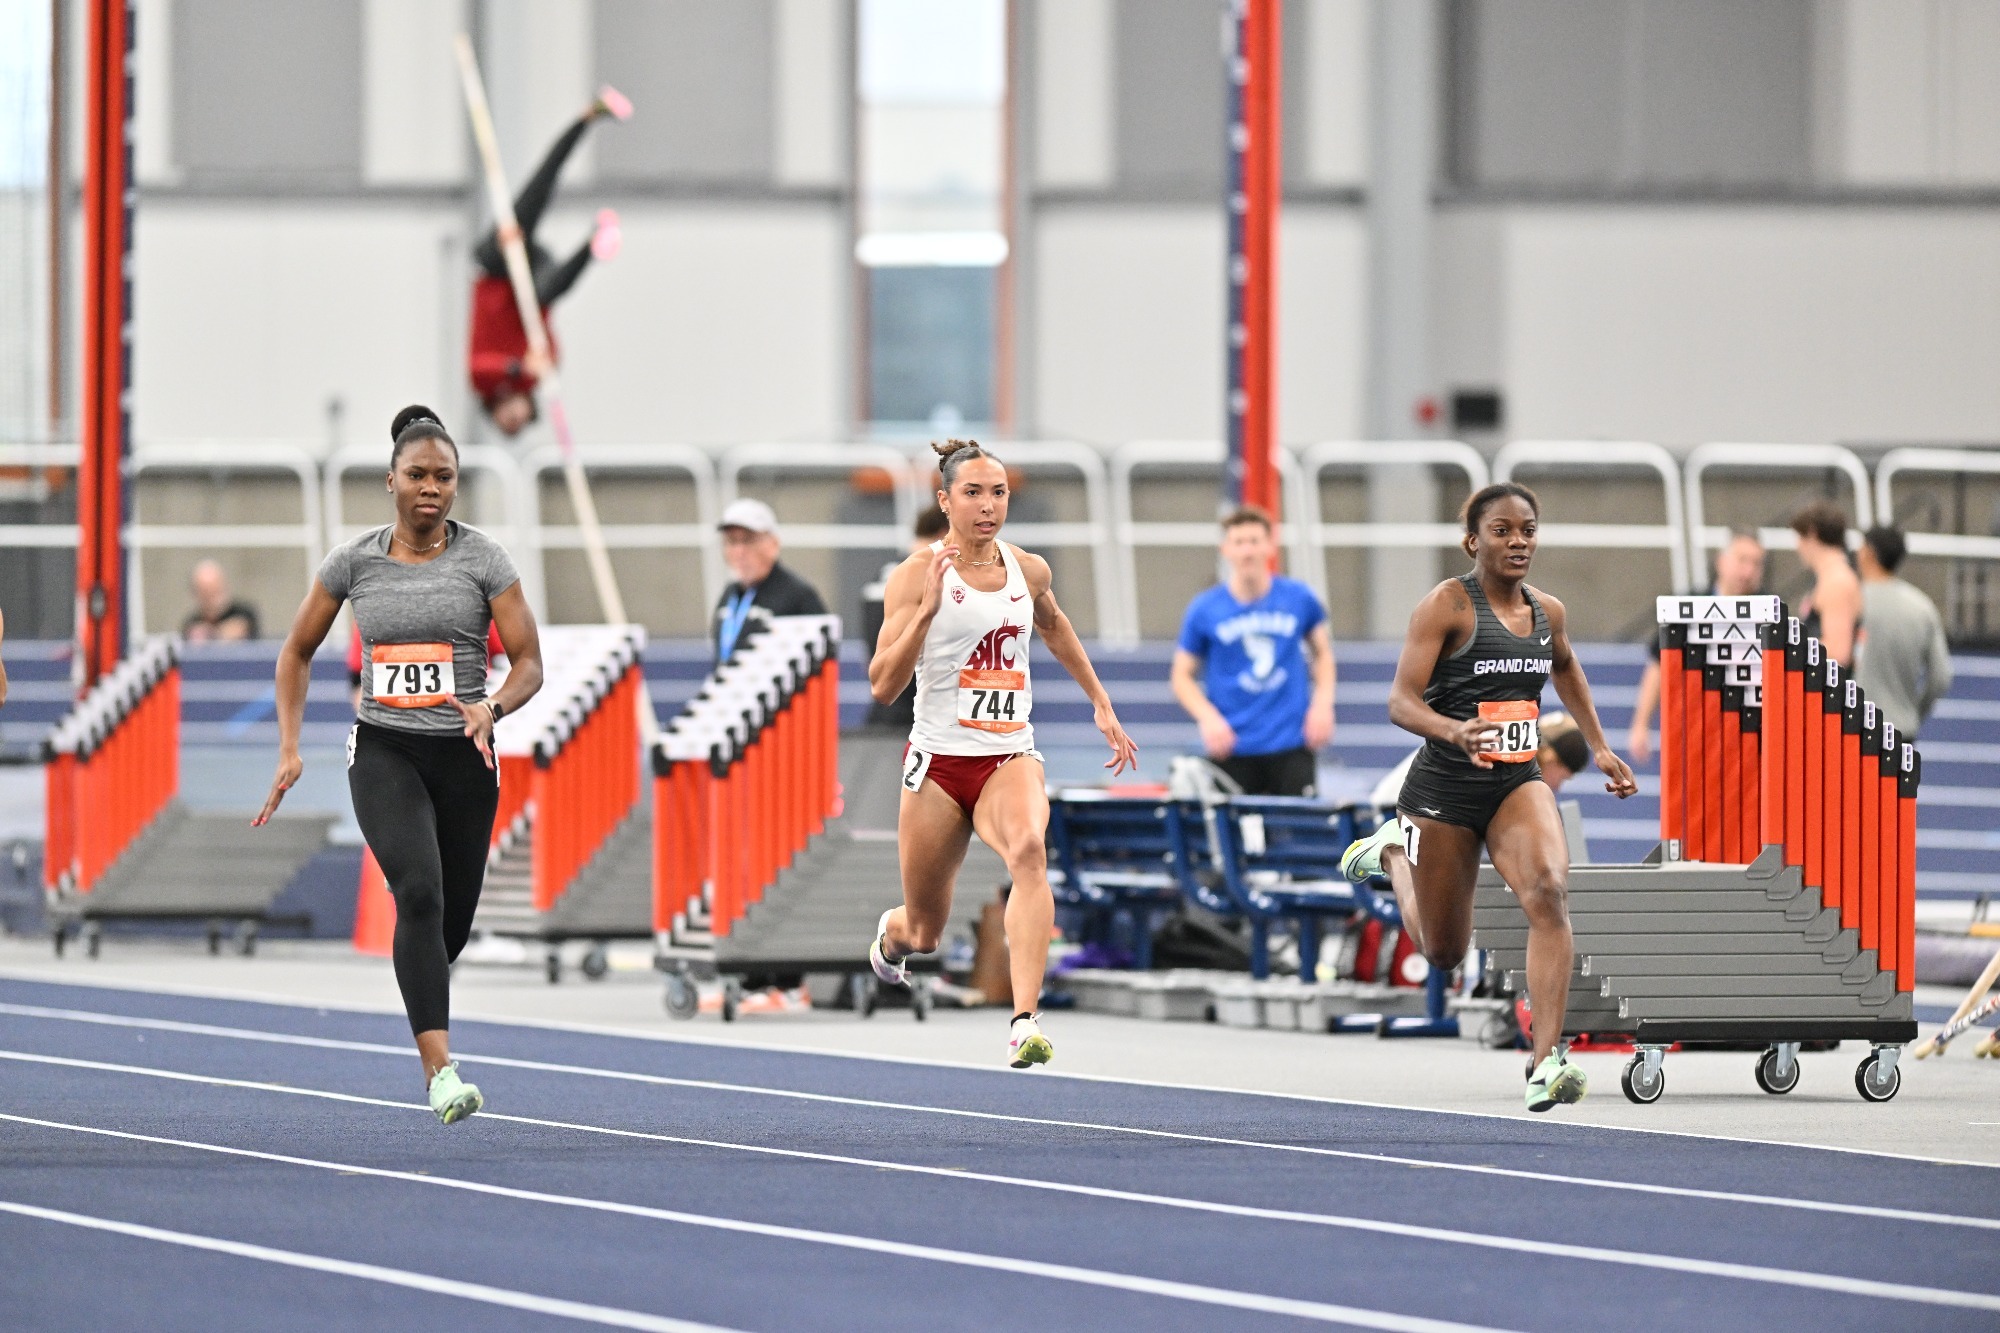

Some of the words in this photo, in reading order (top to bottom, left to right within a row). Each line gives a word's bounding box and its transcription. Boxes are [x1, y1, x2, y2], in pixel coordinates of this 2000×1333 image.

[386, 664, 441, 694] 793
[1474, 659, 1522, 675] GRAND
[971, 690, 1015, 721] 744
[905, 750, 923, 789] 2
[1405, 825, 1414, 857] 1
